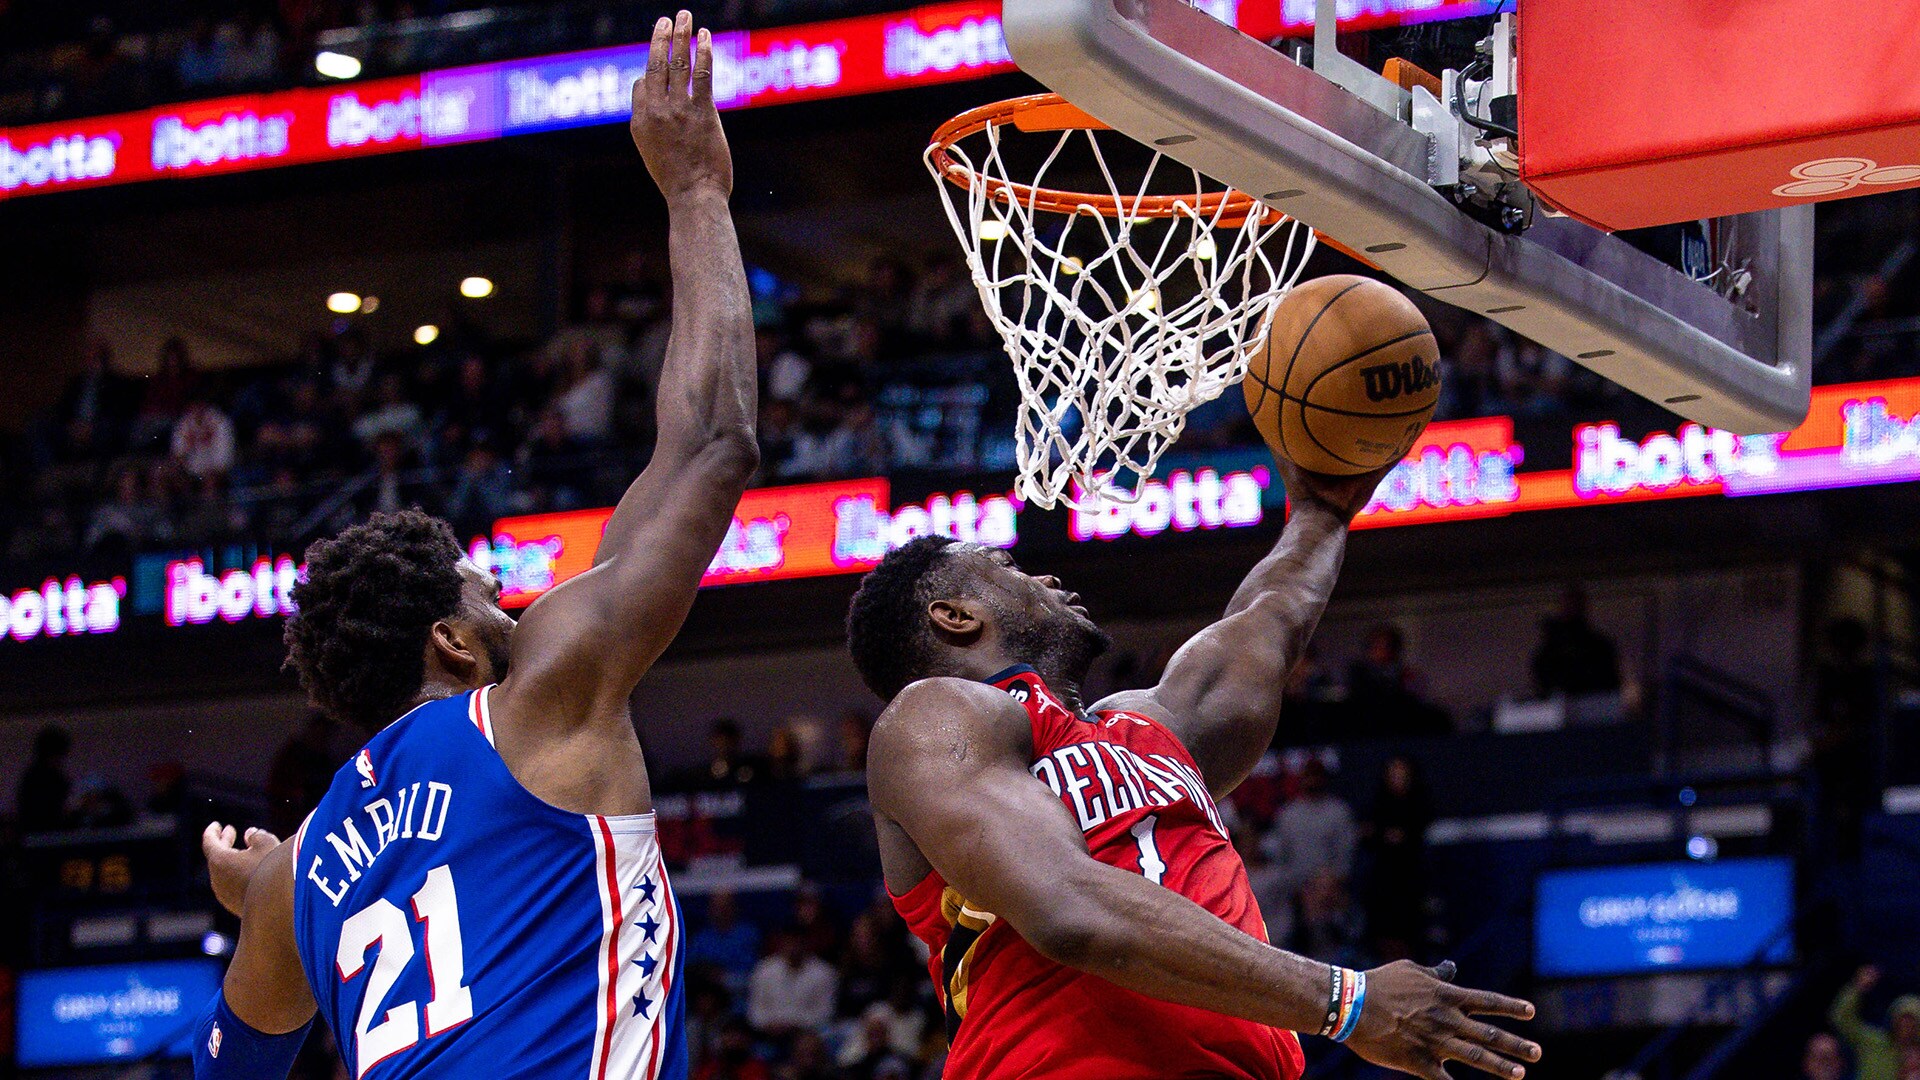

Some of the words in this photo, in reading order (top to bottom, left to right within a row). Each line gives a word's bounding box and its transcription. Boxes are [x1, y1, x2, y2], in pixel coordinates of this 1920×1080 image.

[308, 781, 453, 907] EMBIID
[1130, 814, 1166, 886] 1
[336, 864, 474, 1080] 21
